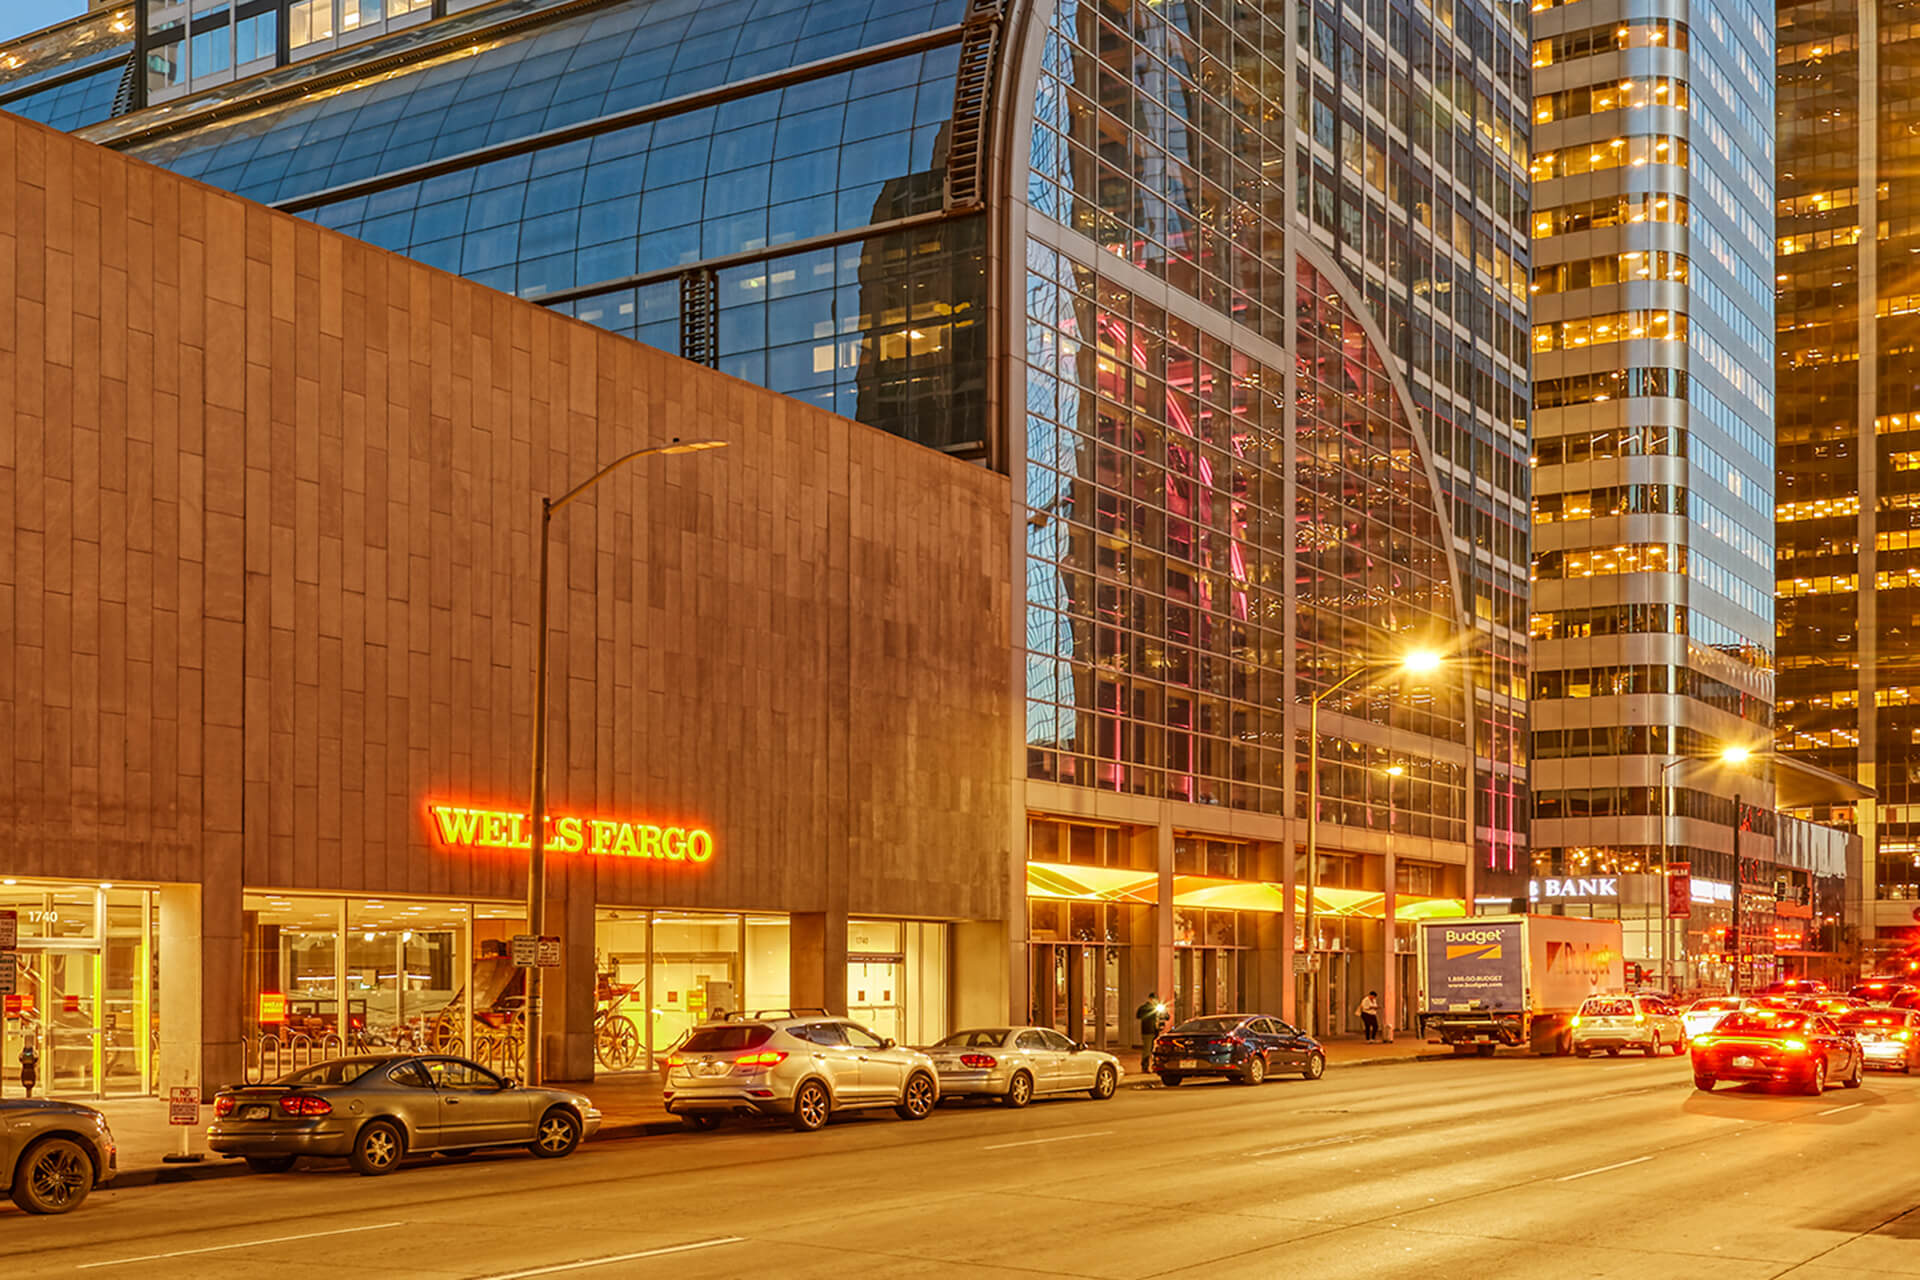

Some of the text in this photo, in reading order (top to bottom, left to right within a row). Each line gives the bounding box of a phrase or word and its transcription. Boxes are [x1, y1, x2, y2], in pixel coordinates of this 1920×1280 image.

[589, 819, 712, 862] FARGO
[1545, 878, 1618, 897] BANK
[28, 911, 58, 923] 1740
[1446, 929, 1502, 945] Budget
